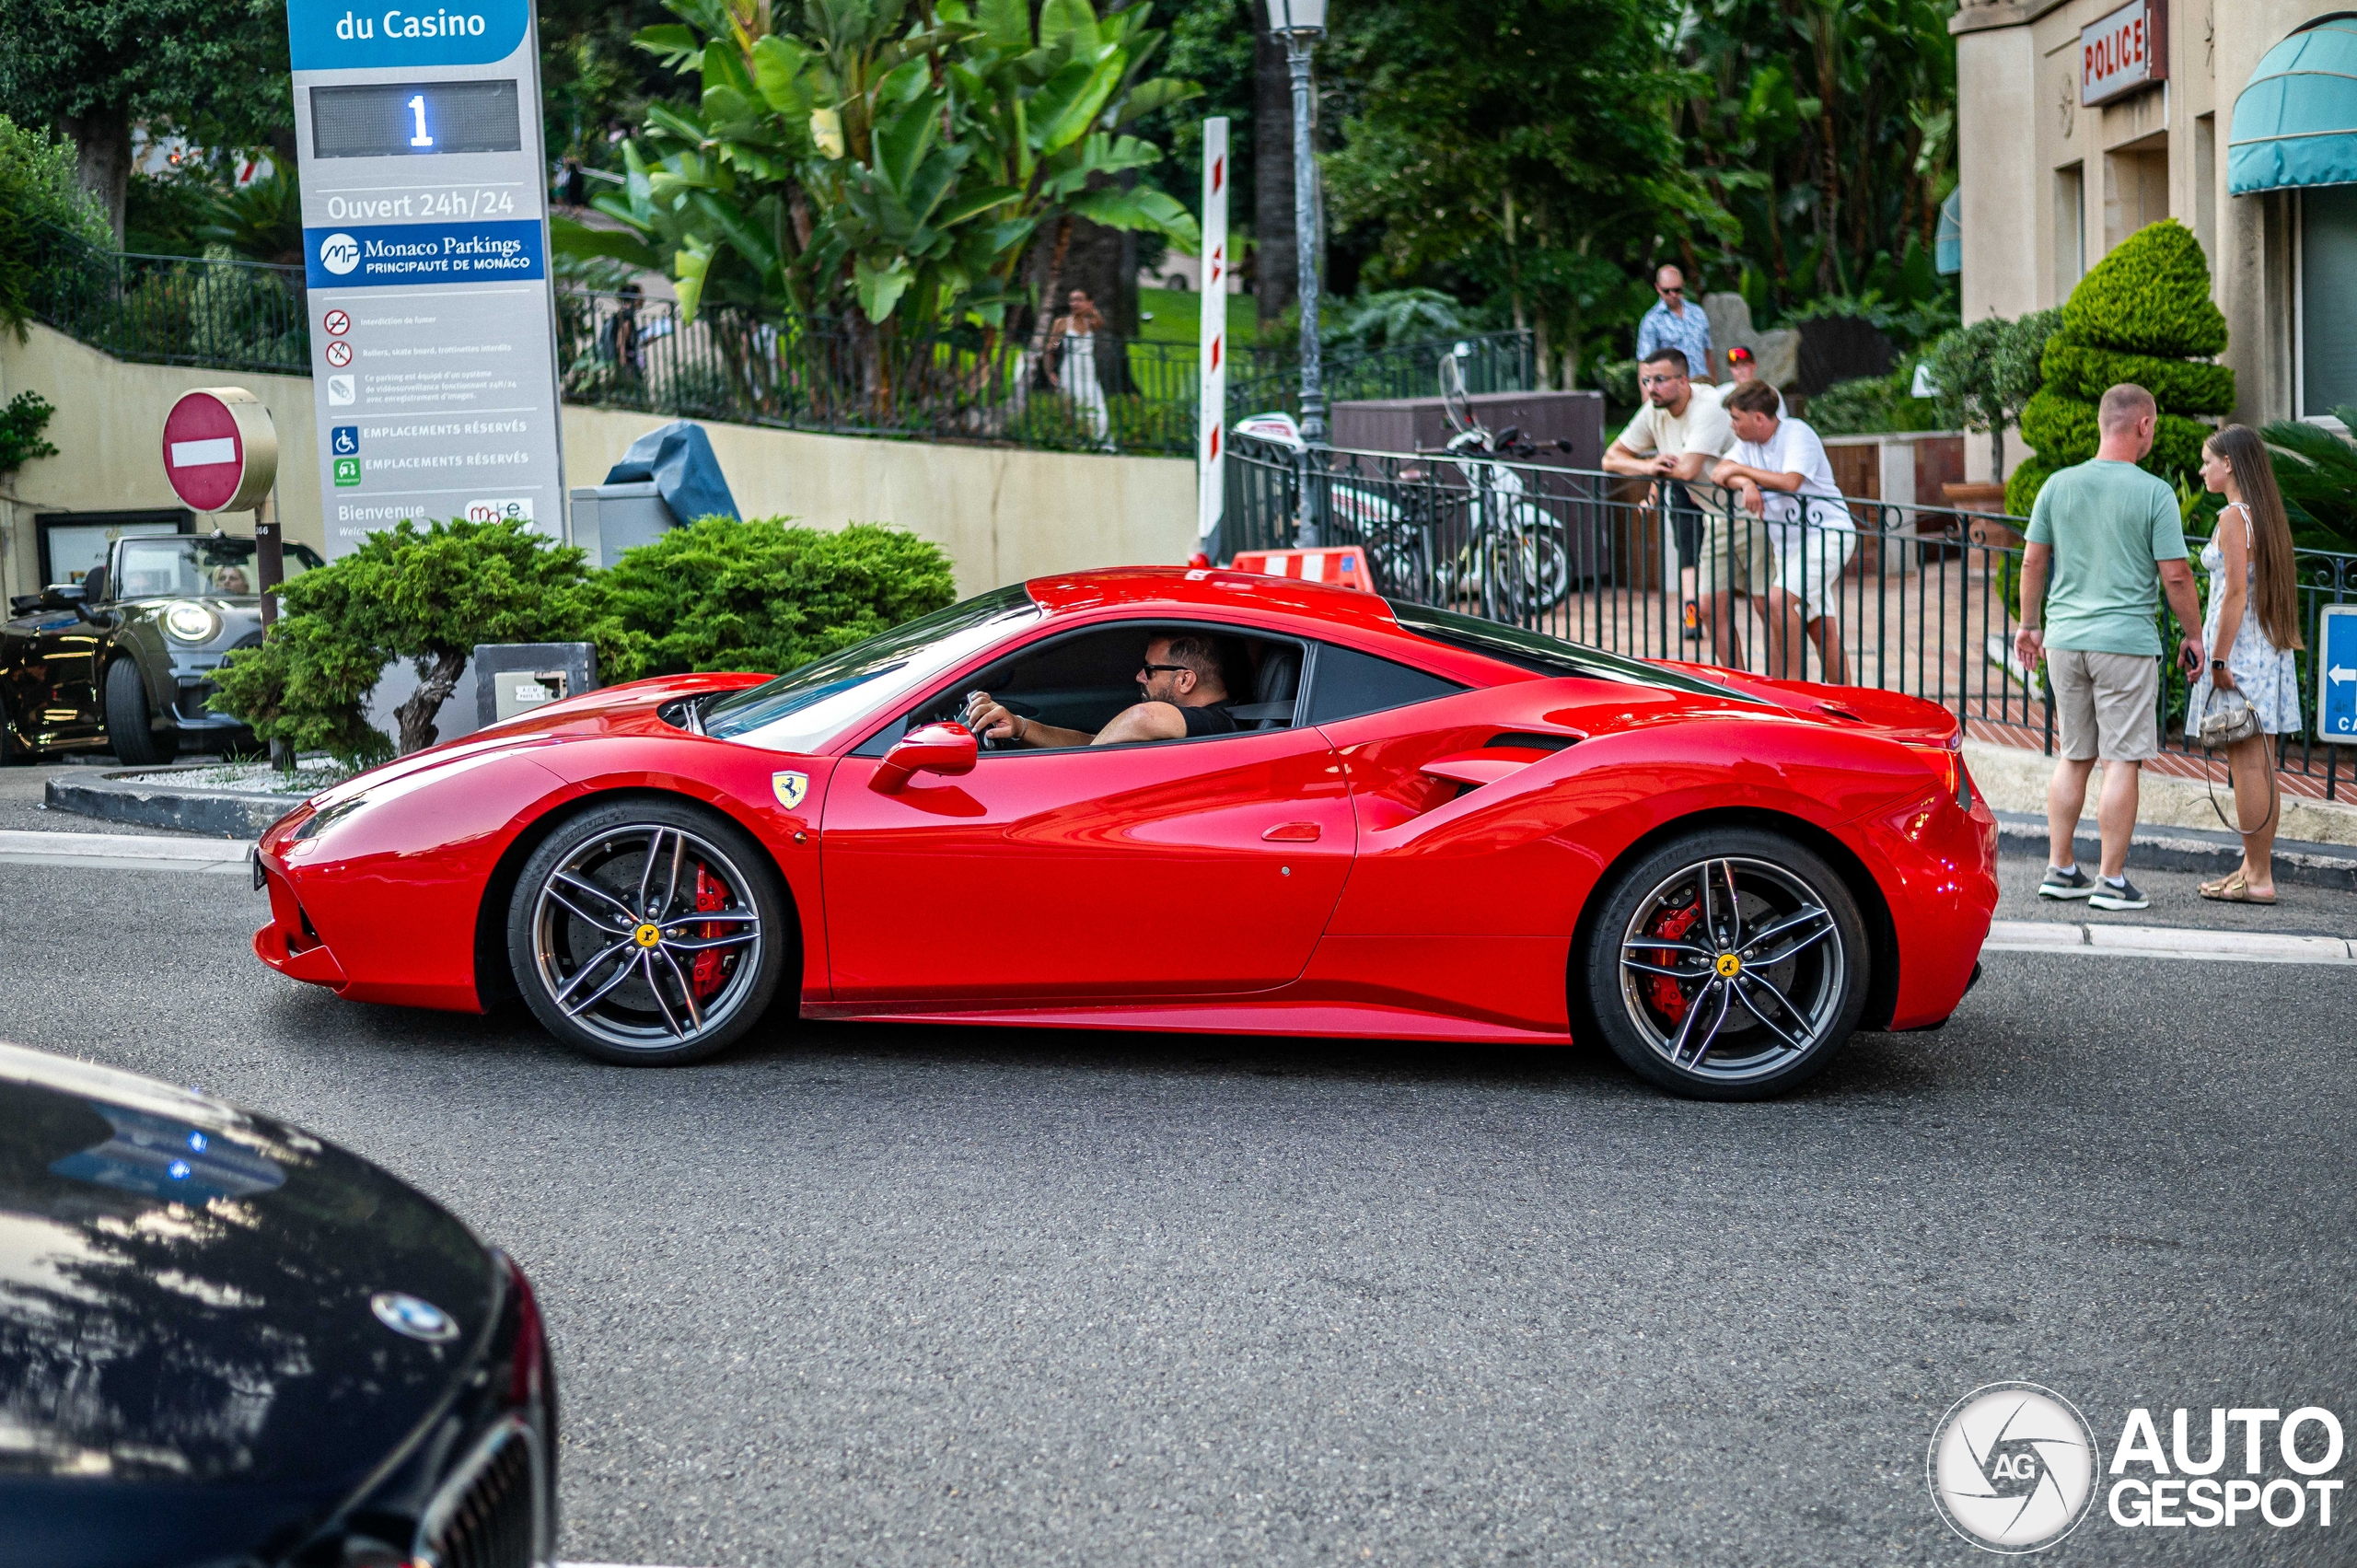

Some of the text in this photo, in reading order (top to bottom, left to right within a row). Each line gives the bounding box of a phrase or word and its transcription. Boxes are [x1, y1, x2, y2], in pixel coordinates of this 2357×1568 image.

[336, 8, 485, 40] du Casino
[2084, 17, 2143, 87] POLICE
[408, 95, 434, 147] 1
[328, 190, 515, 220] Ouvert 24h/24
[365, 236, 522, 258] Monaco Parkings
[366, 257, 530, 273] PRINCIPAUTÉ DE MONACO
[360, 317, 402, 326] Interdiction
[404, 316, 413, 324] de
[392, 347, 412, 355] skate
[376, 373, 403, 383] parking
[366, 385, 375, 393] de
[364, 419, 528, 439] EMPLACEMENTS RÉSERVÉS
[366, 450, 529, 470] EMPLACEMENTS RÉSERVÉS
[339, 505, 425, 521] Bienvenue
[554, 815, 607, 851] MICHELIN
